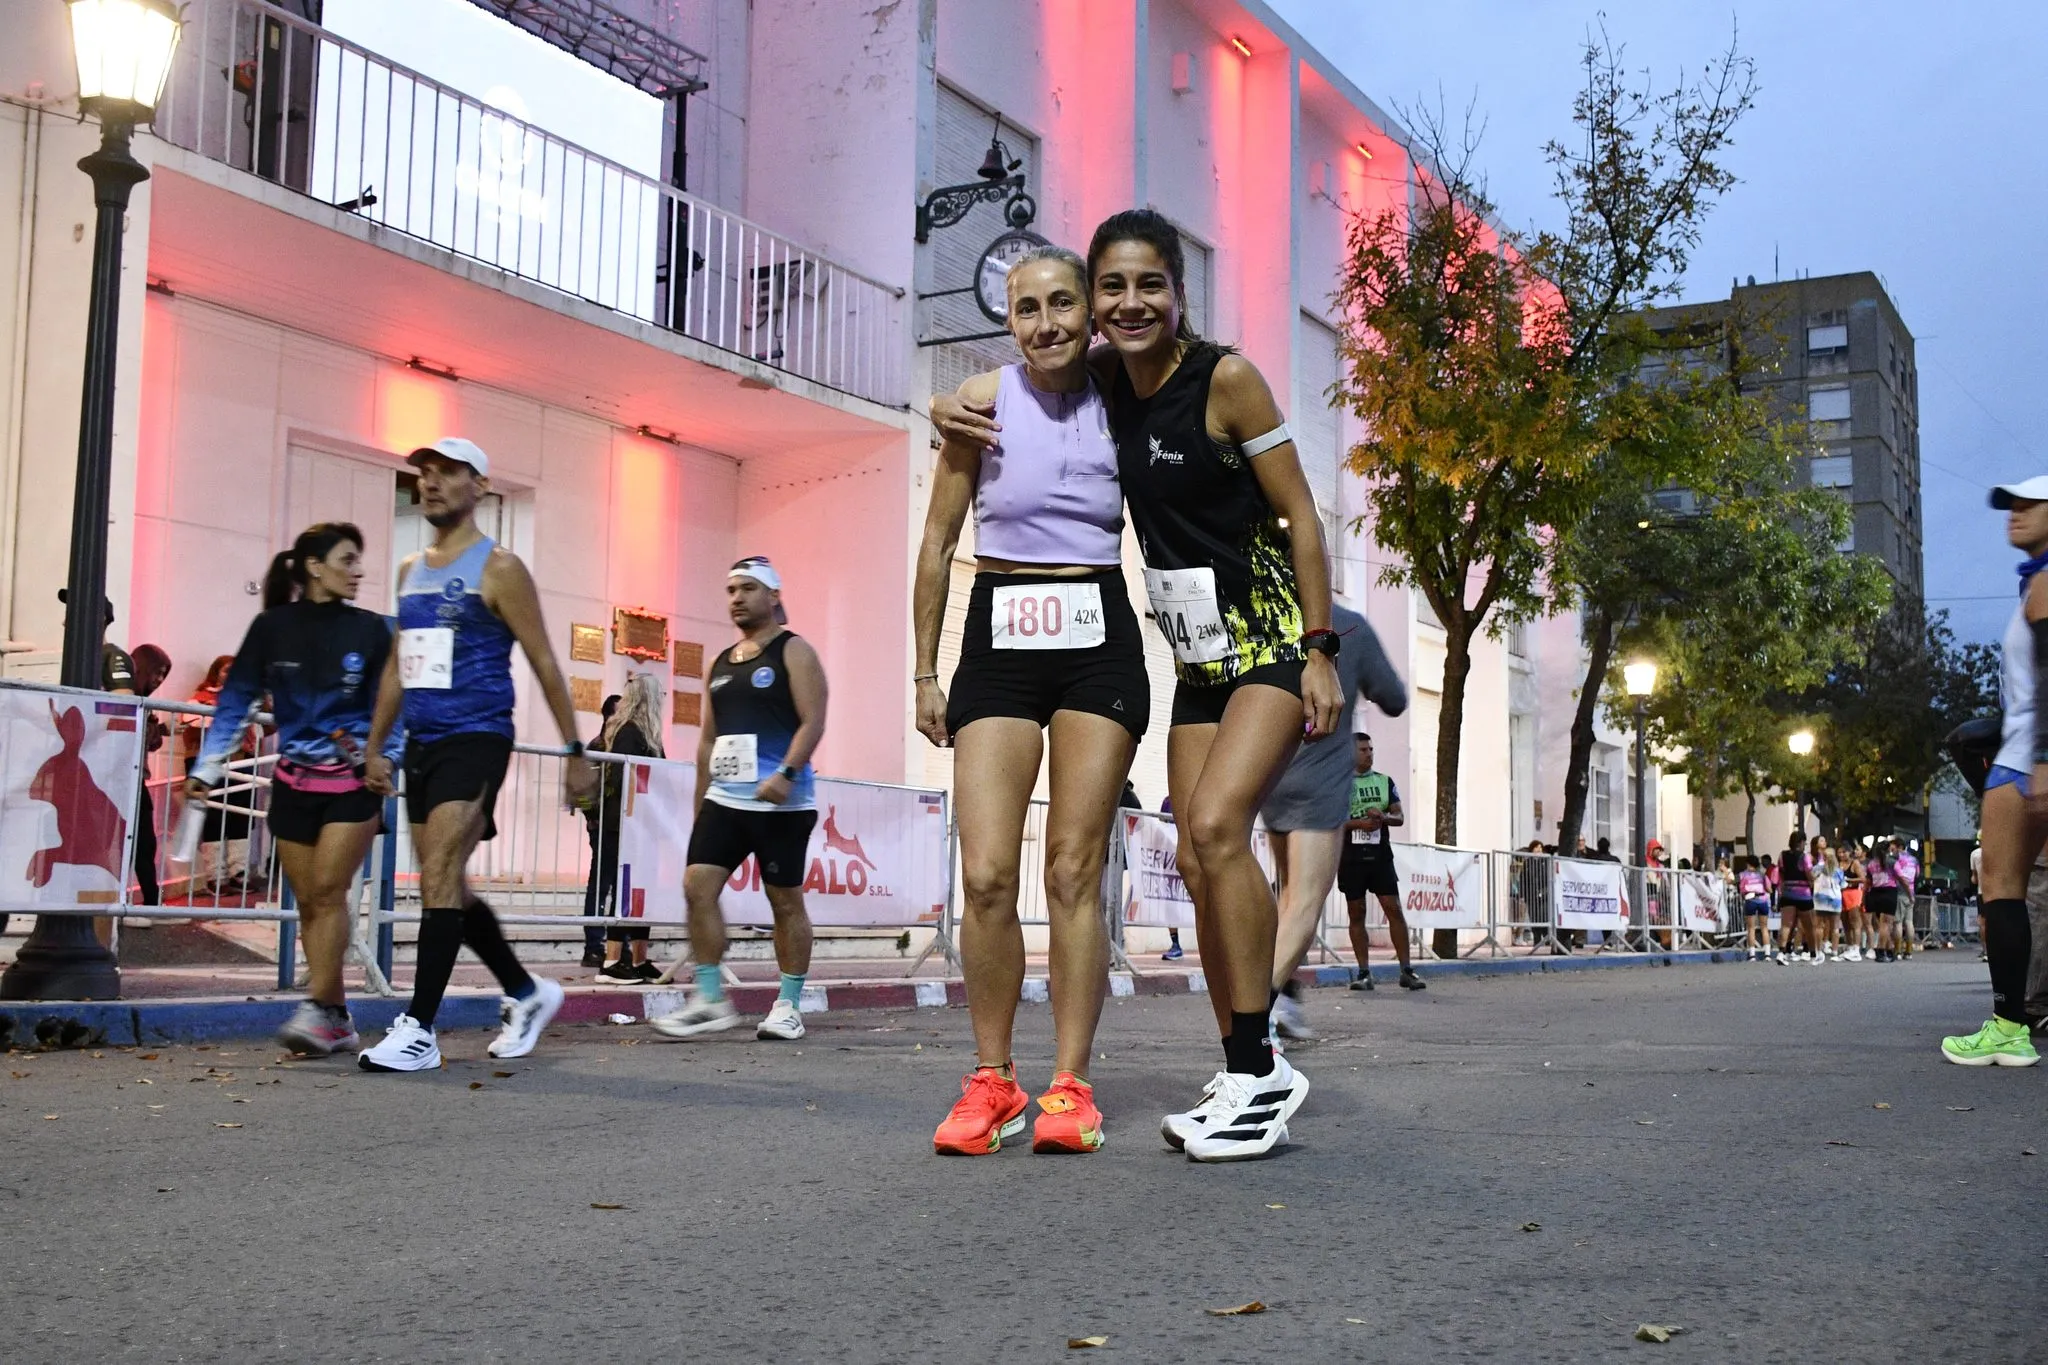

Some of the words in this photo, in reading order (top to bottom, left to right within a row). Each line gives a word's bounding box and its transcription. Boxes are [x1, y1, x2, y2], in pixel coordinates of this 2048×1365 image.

[997, 248, 1006, 260] 11
[1010, 242, 1021, 253] 12
[983, 277, 989, 288] 9
[1157, 449, 1184, 461] Fénix
[1005, 596, 1062, 637] 180
[1074, 608, 1099, 625] 42K
[1154, 609, 1191, 651] 04
[1196, 623, 1221, 640] 21K
[869, 885, 893, 897] S.R.L.
[1407, 889, 1454, 912] GONZALO
